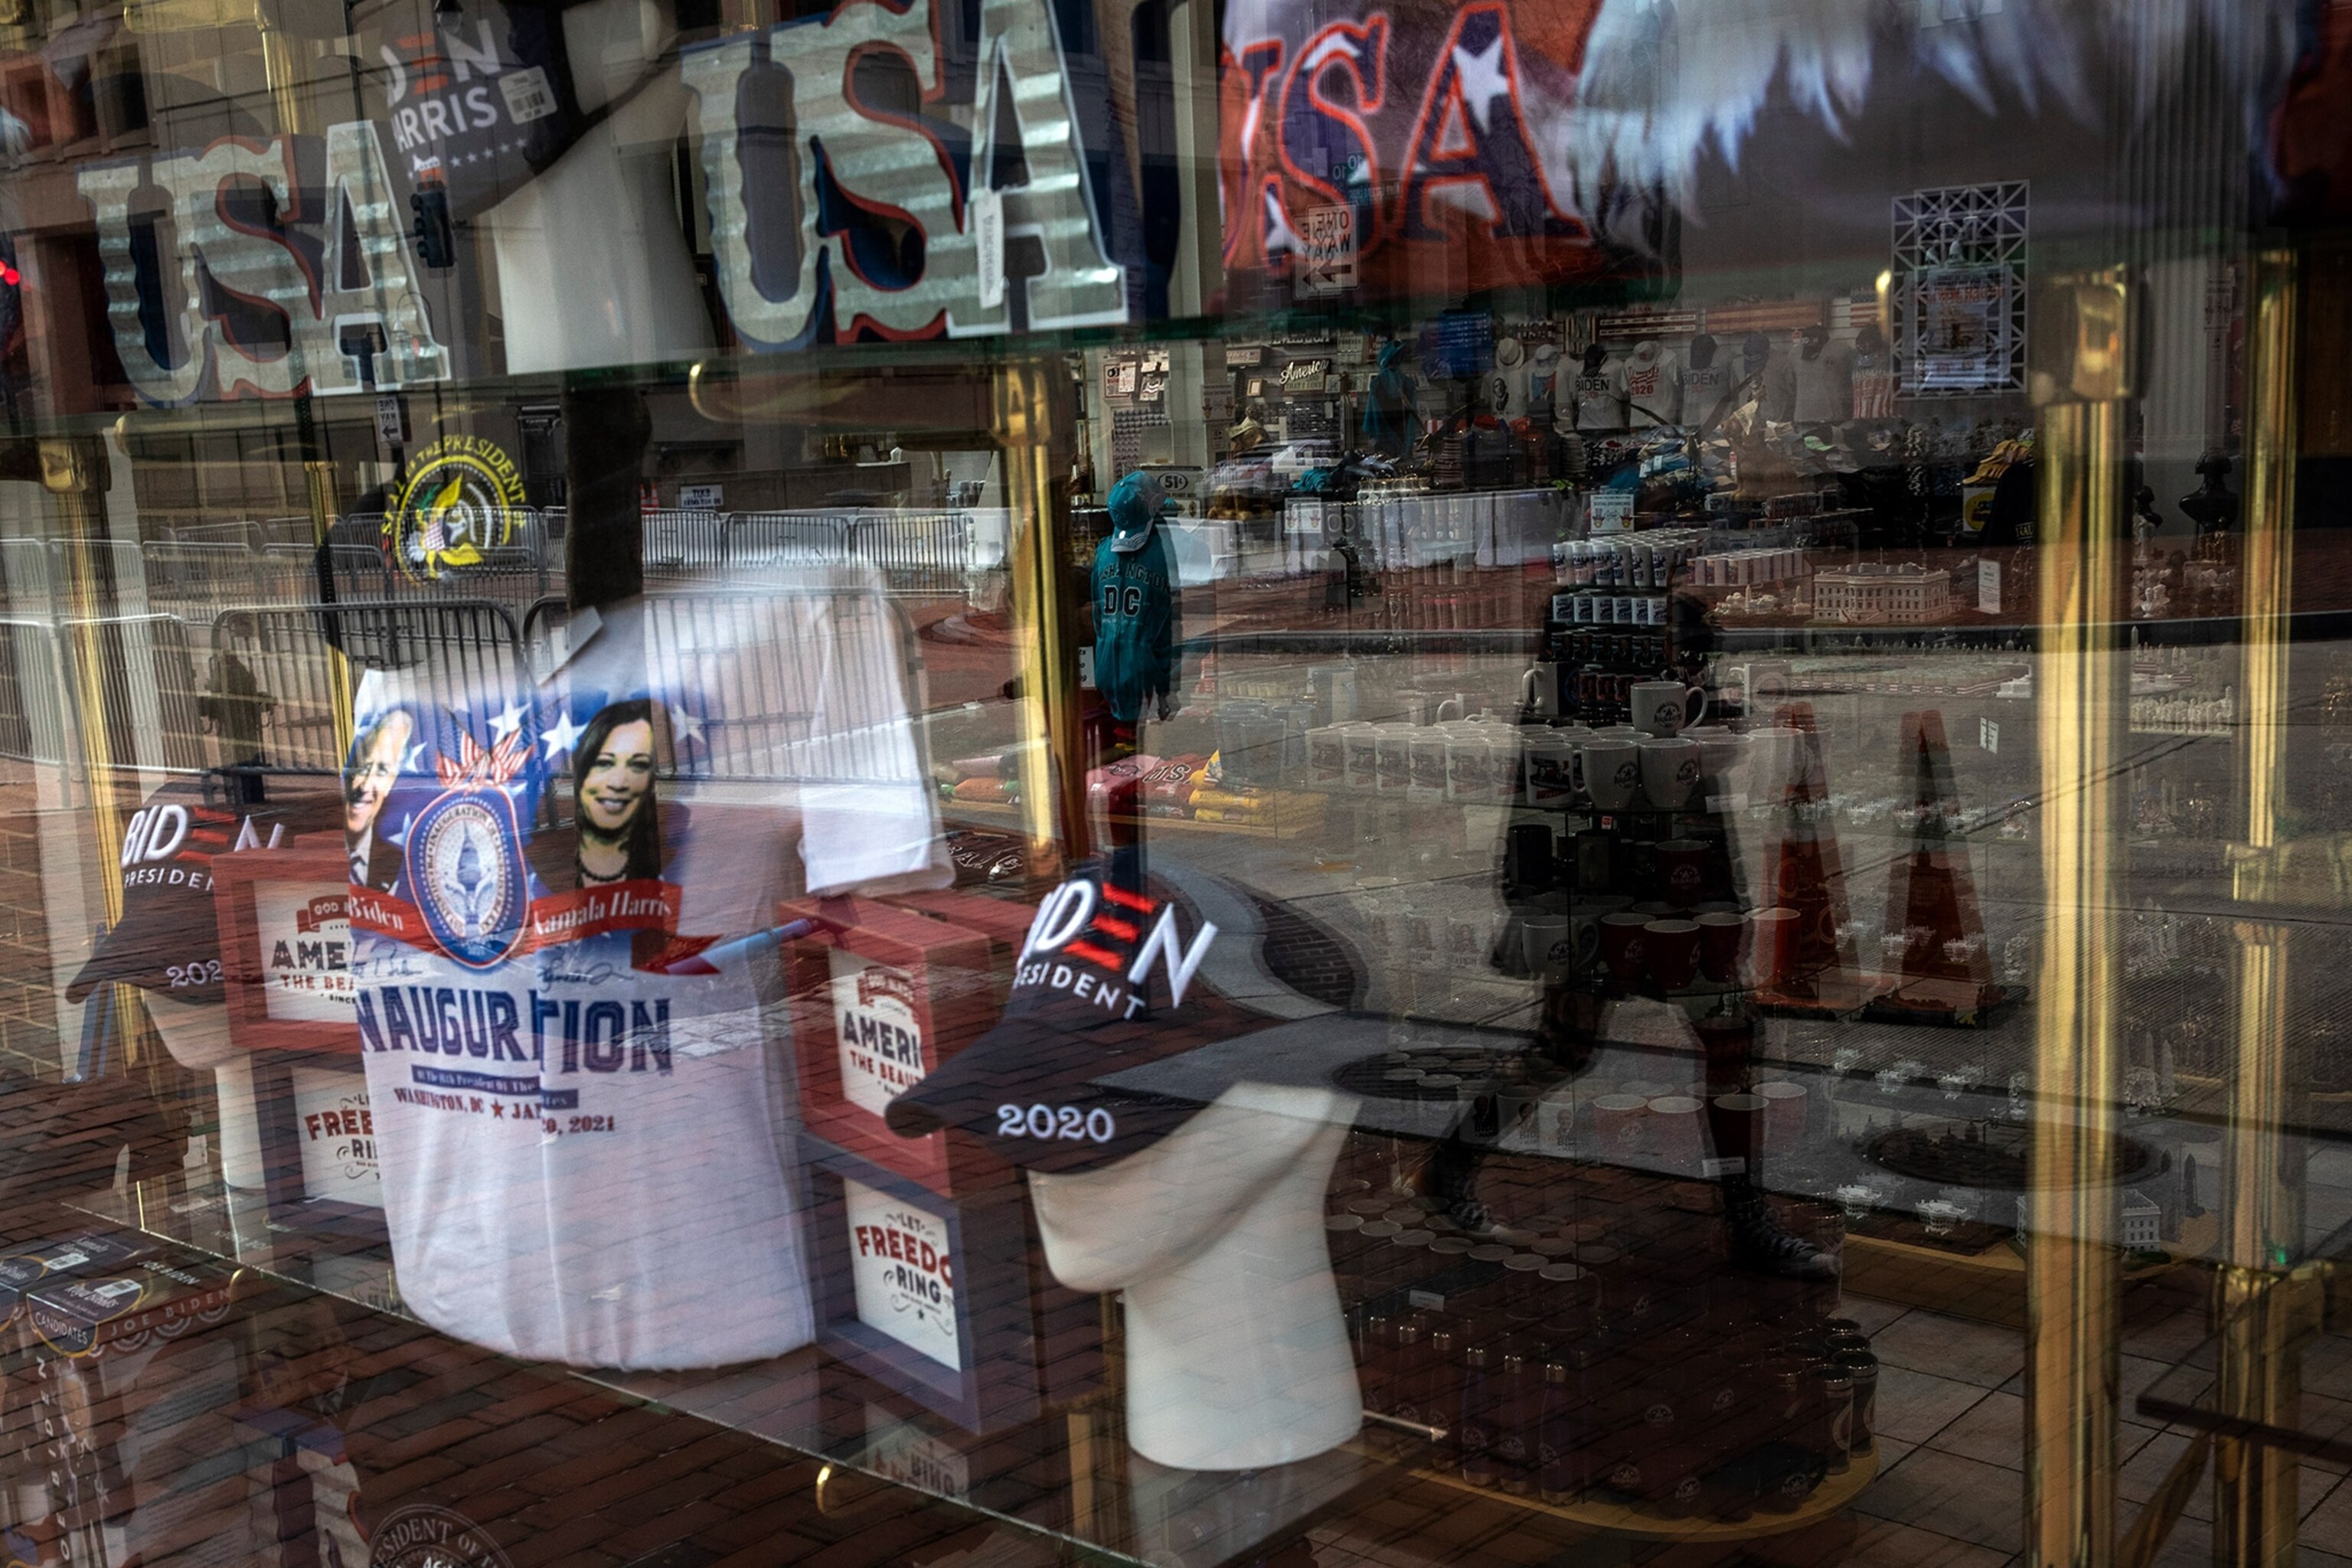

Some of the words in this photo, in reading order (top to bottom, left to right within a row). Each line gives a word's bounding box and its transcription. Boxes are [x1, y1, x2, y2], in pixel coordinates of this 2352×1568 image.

[681, 0, 1129, 354] USA
[77, 119, 451, 408] USA
[1279, 360, 1330, 384] America
[1576, 378, 1610, 392] BIDEN
[1682, 372, 1719, 386] BIDEN
[1631, 385, 1655, 395] 2020
[443, 434, 527, 503] PRESIDENT
[315, 901, 340, 916] GOD
[271, 939, 348, 972] AME
[280, 975, 315, 990] THE
[1014, 962, 1146, 1020] ESIDENT
[850, 1050, 876, 1074] THE
[569, 1115, 615, 1133] 2021
[998, 1103, 1116, 1144] 2020
[896, 1264, 942, 1304] RING
[110, 1313, 151, 1336] JOE
[165, 1287, 230, 1318] BIDEN
[34, 1311, 89, 1346] CANDIDATES
